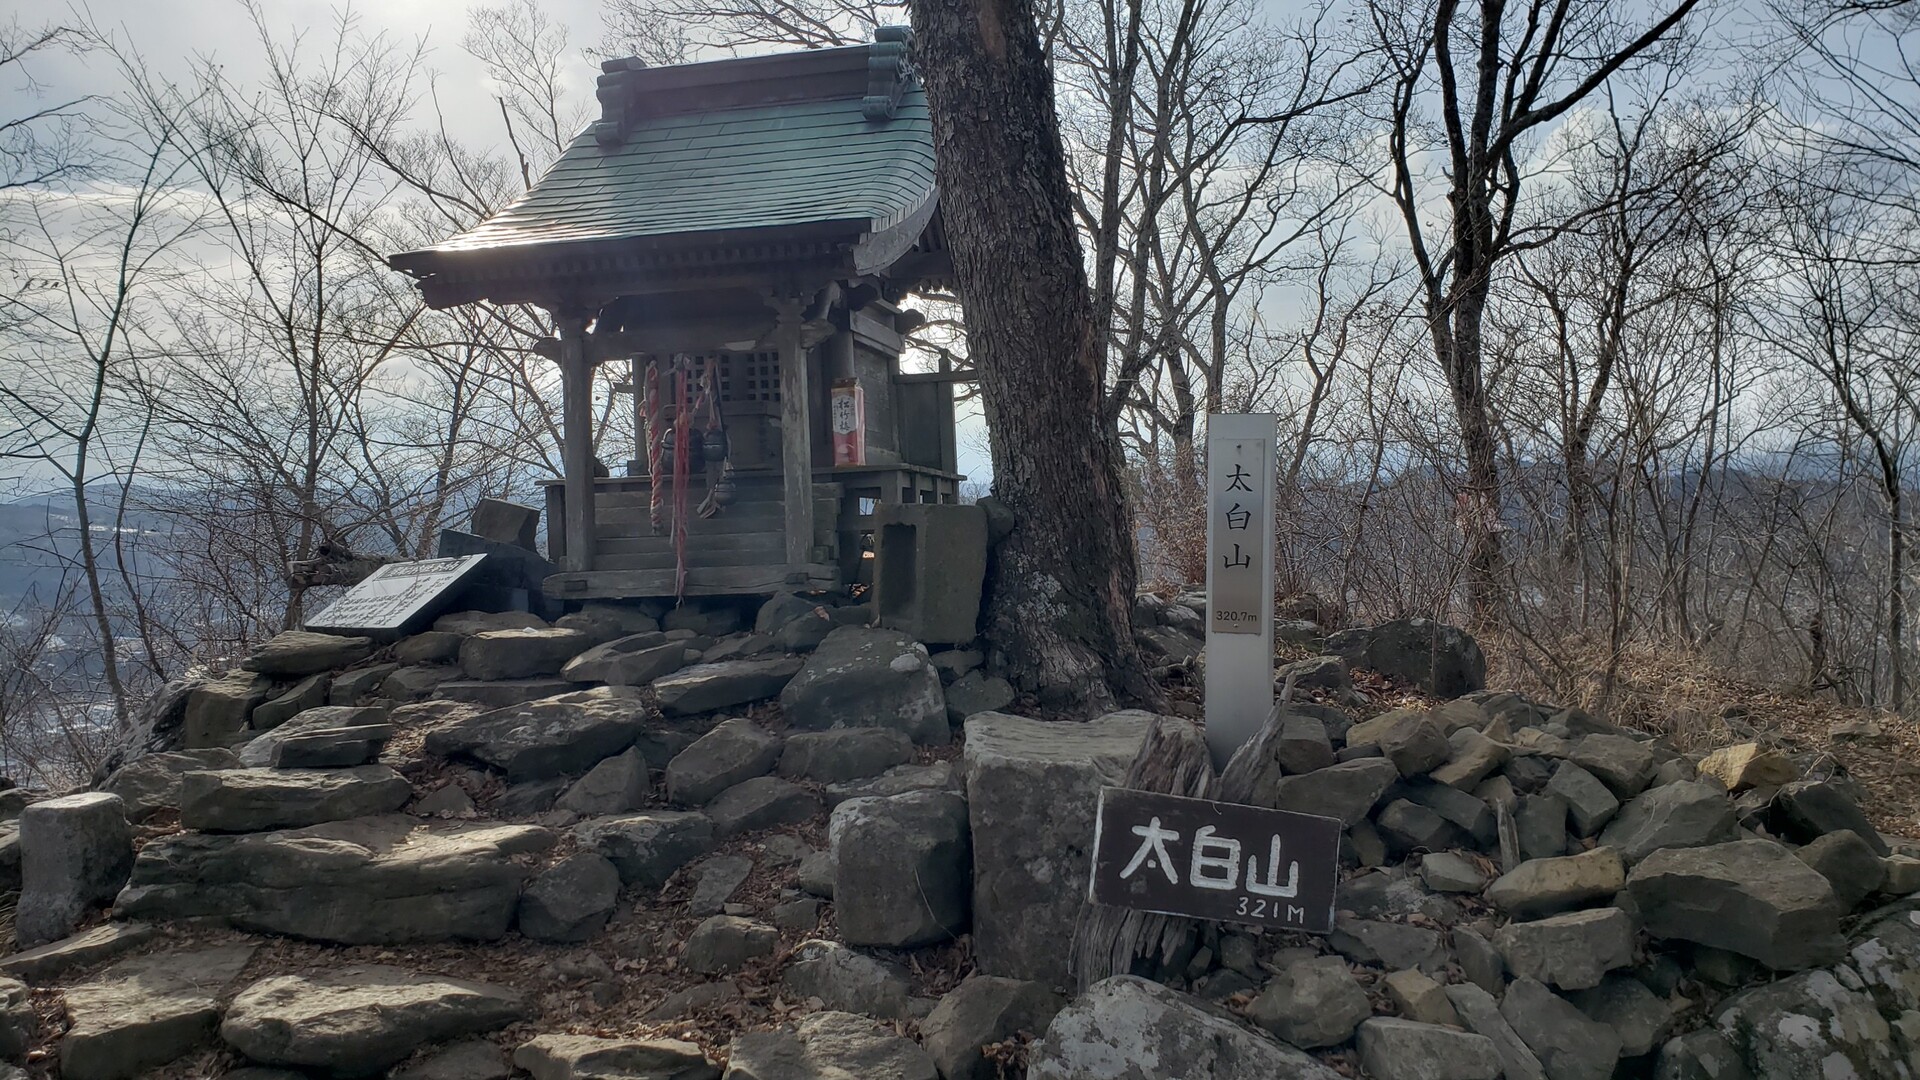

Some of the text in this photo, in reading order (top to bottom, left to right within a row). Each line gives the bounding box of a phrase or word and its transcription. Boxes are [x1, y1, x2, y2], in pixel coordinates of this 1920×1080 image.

[838, 399, 850, 431] 松竹梅
[1222, 463, 1253, 569] 太白山
[1216, 610, 1257, 622] 320.7m
[1119, 816, 1299, 898] 太白山
